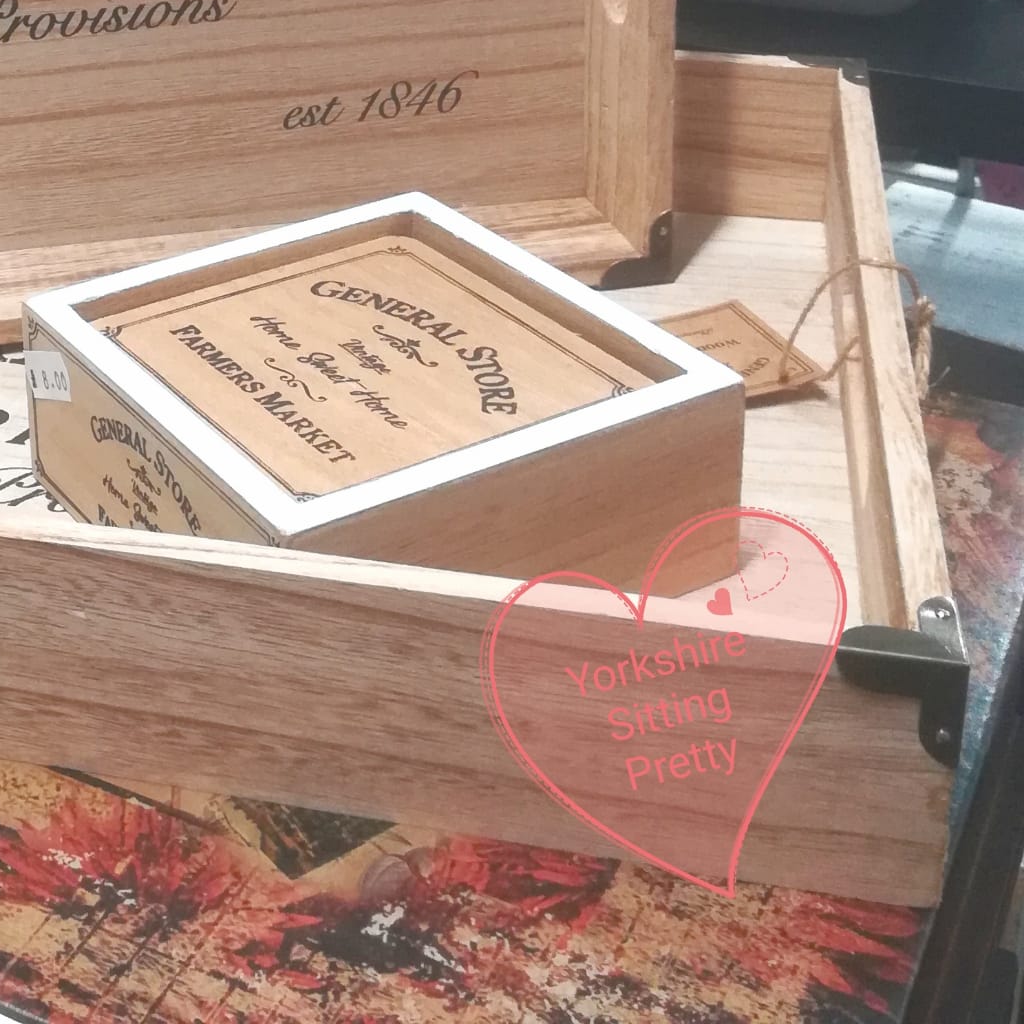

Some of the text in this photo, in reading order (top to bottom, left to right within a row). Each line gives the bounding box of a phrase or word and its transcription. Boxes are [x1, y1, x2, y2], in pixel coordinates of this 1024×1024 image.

[282, 69, 480, 131] est 1846
[169, 323, 357, 464] FARMERS MARKET
[249, 315, 409, 431] Home Sweet Home
[309, 279, 518, 416] GENERAL STORE
[337, 337, 393, 376] Vintage
[89, 415, 201, 538] GENERAL STORE
